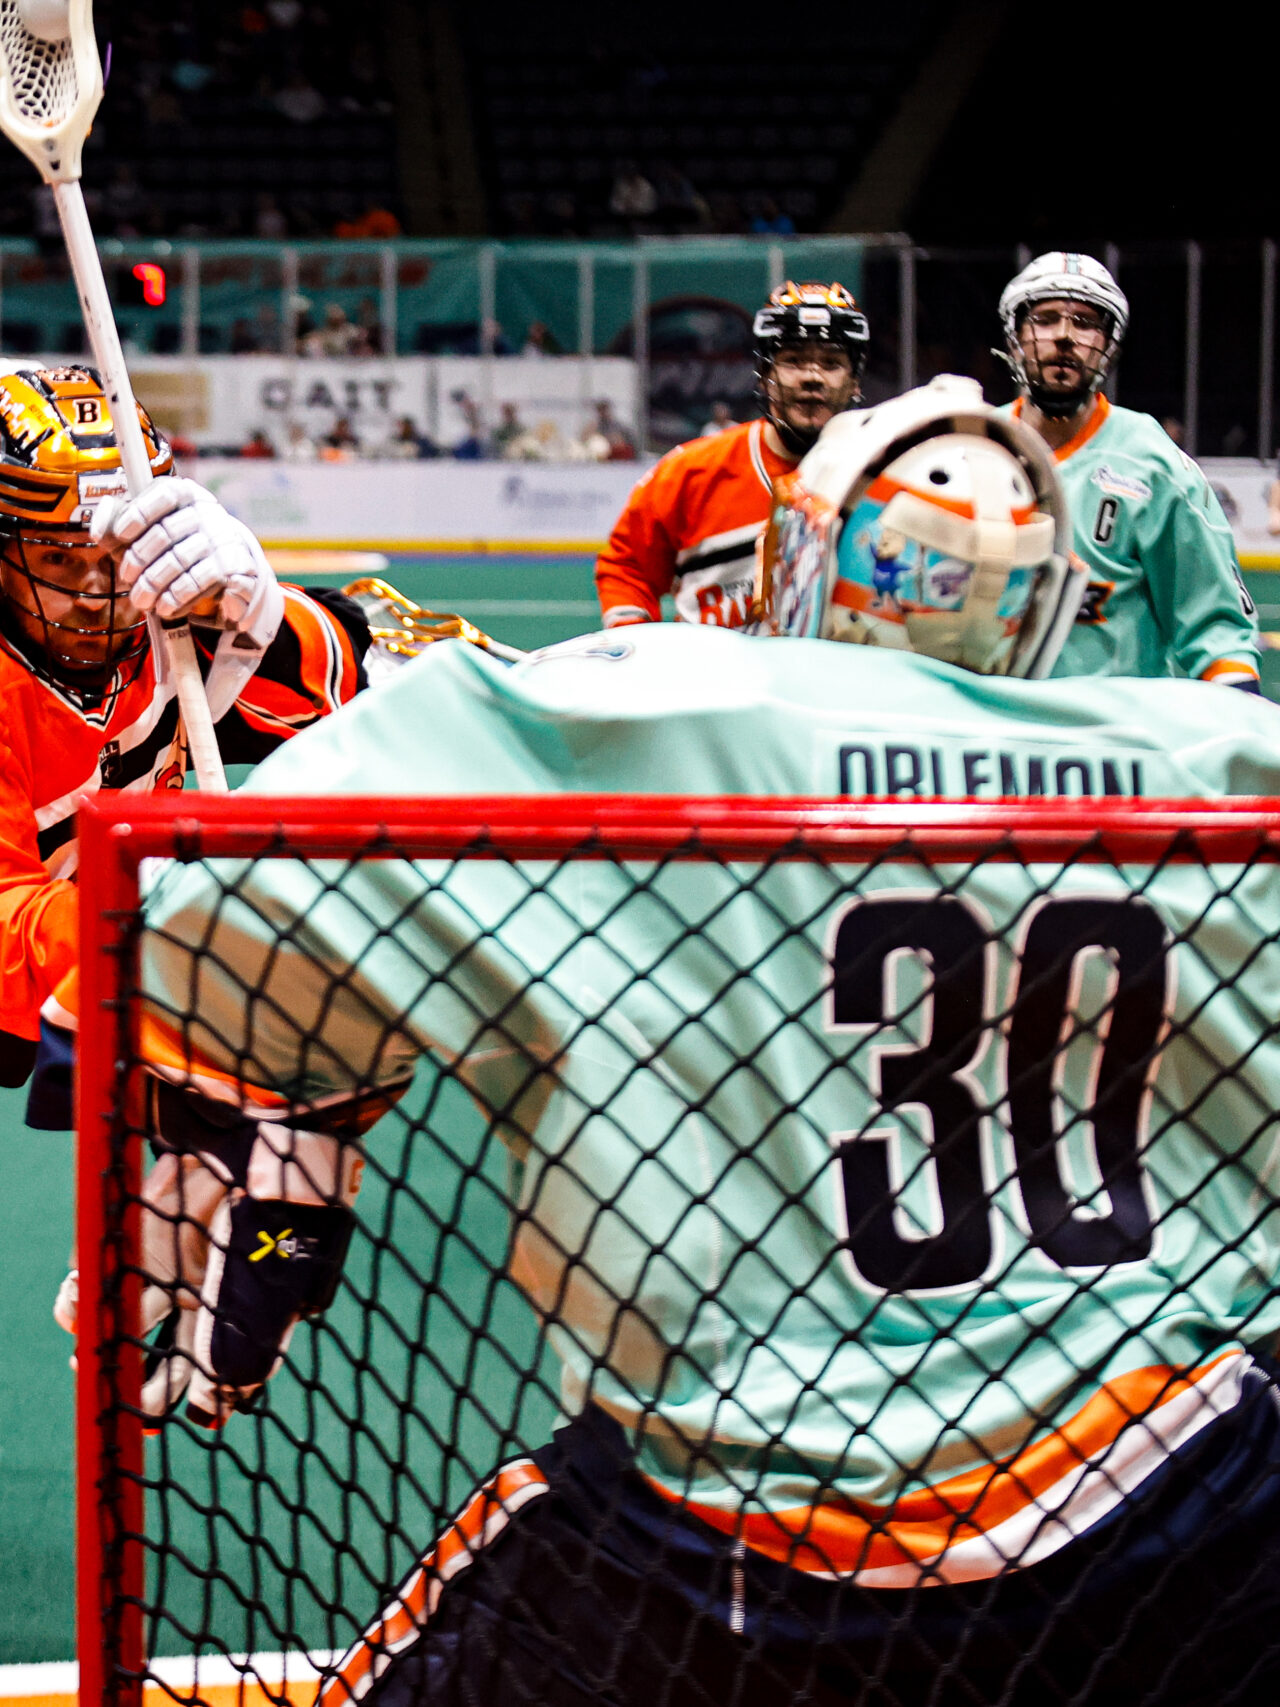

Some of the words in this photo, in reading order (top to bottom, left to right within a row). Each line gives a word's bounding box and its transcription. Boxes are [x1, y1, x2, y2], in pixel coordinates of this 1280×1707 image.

[74, 399, 102, 425] B
[1093, 496, 1118, 546] C
[824, 887, 1179, 1297] 30
